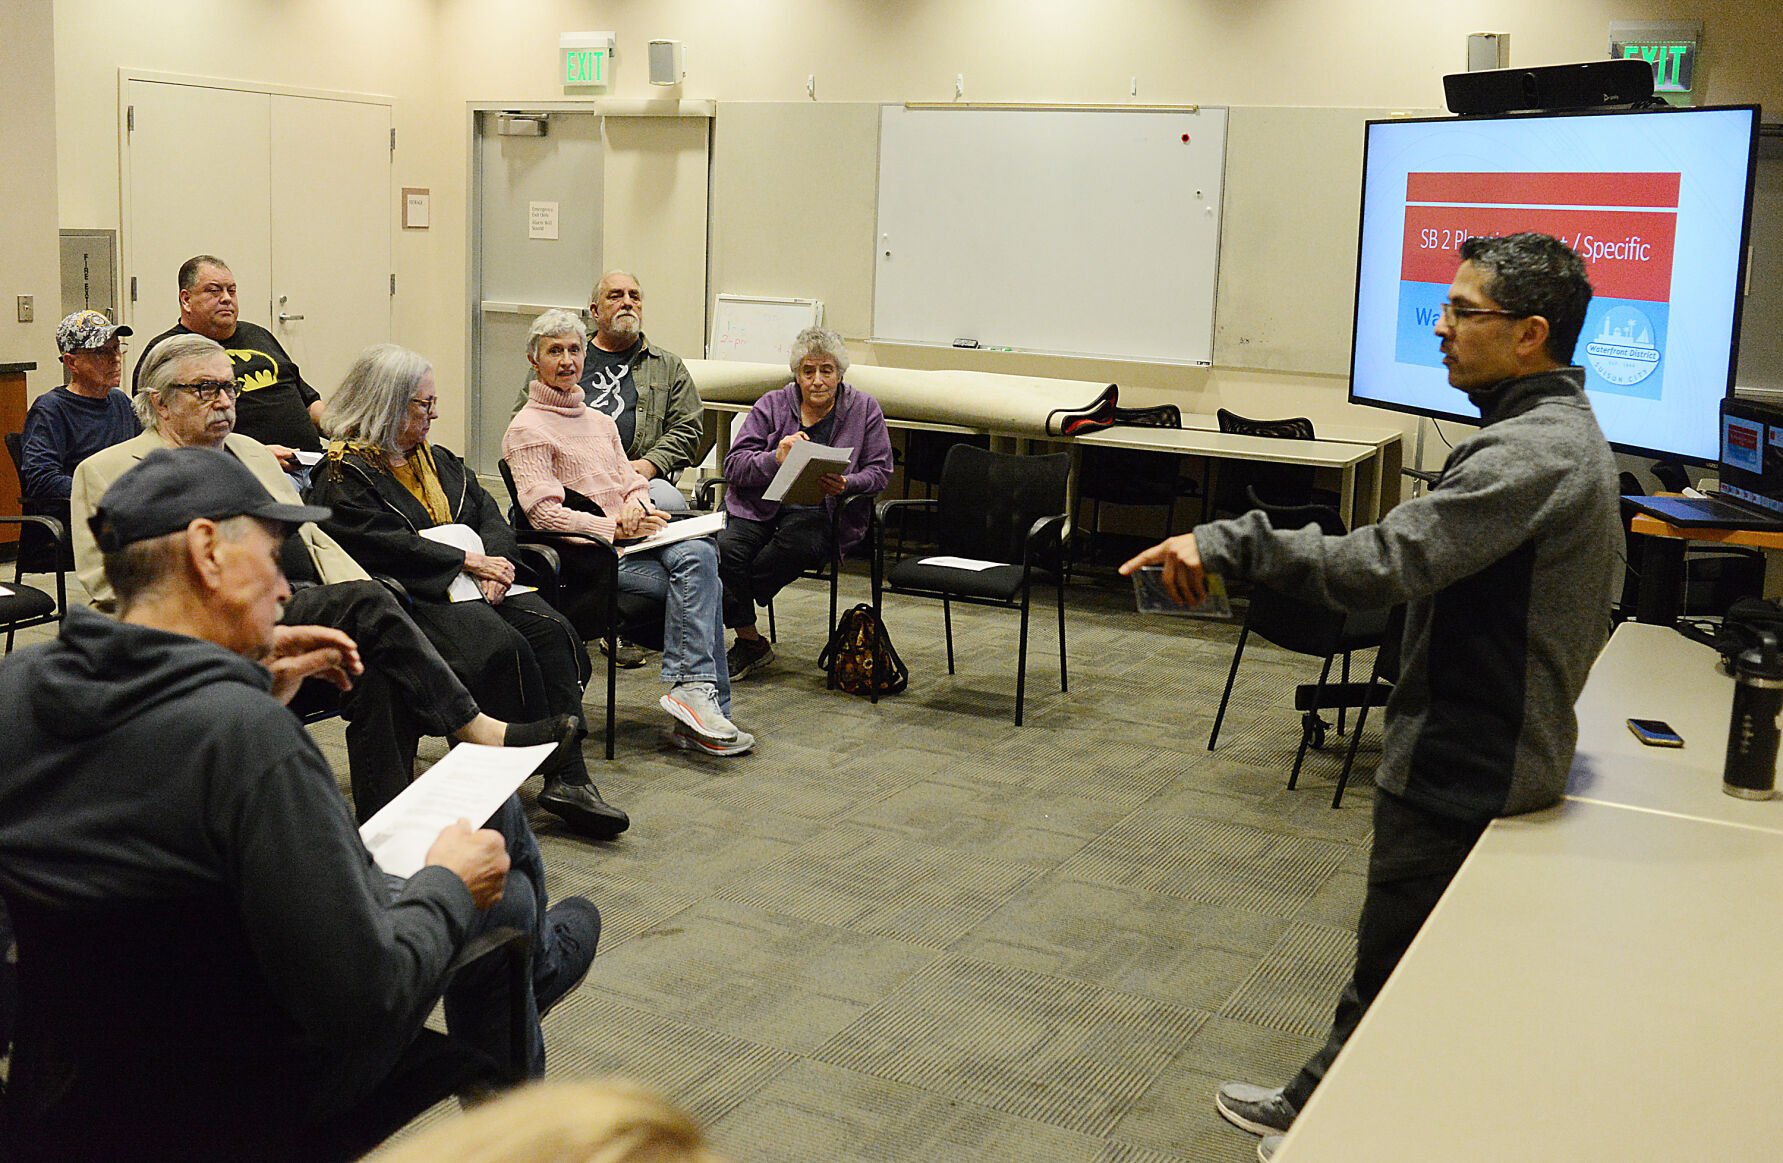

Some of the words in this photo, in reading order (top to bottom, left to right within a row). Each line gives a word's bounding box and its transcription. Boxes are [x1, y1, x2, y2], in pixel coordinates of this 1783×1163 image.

[567, 52, 604, 81] EXIT
[1623, 46, 1687, 86] IT
[1420, 228, 1438, 249] SB
[1441, 229, 1451, 250] 2
[1582, 235, 1651, 263] Specific
[1590, 344, 1628, 356] Waterfront
[1629, 349, 1657, 360] District
